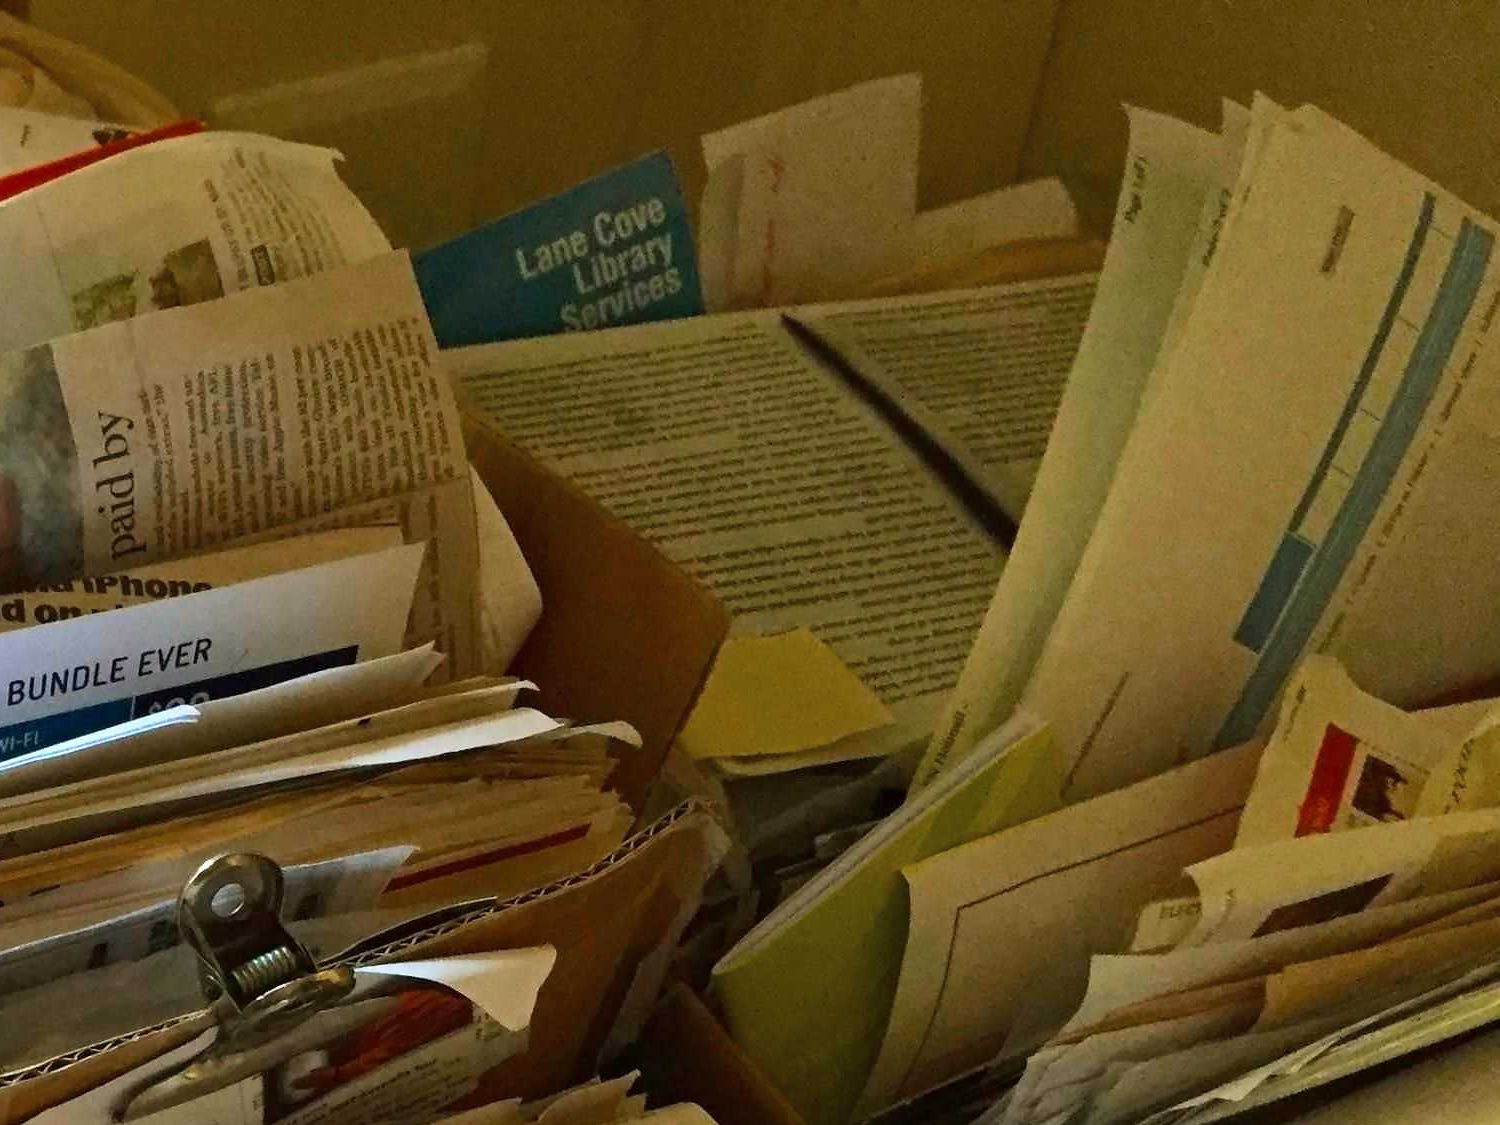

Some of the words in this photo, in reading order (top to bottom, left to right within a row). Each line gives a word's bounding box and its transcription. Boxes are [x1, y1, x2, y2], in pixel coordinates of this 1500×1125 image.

[516, 231, 588, 280] Lane
[594, 199, 666, 246] Cove
[573, 232, 672, 294] Library
[561, 267, 682, 330] Services
[93, 410, 134, 470] by
[99, 473, 146, 562] paid
[83, 575, 213, 599] iPhone
[7, 656, 129, 707] BUNDLE
[138, 638, 213, 677] EVER
